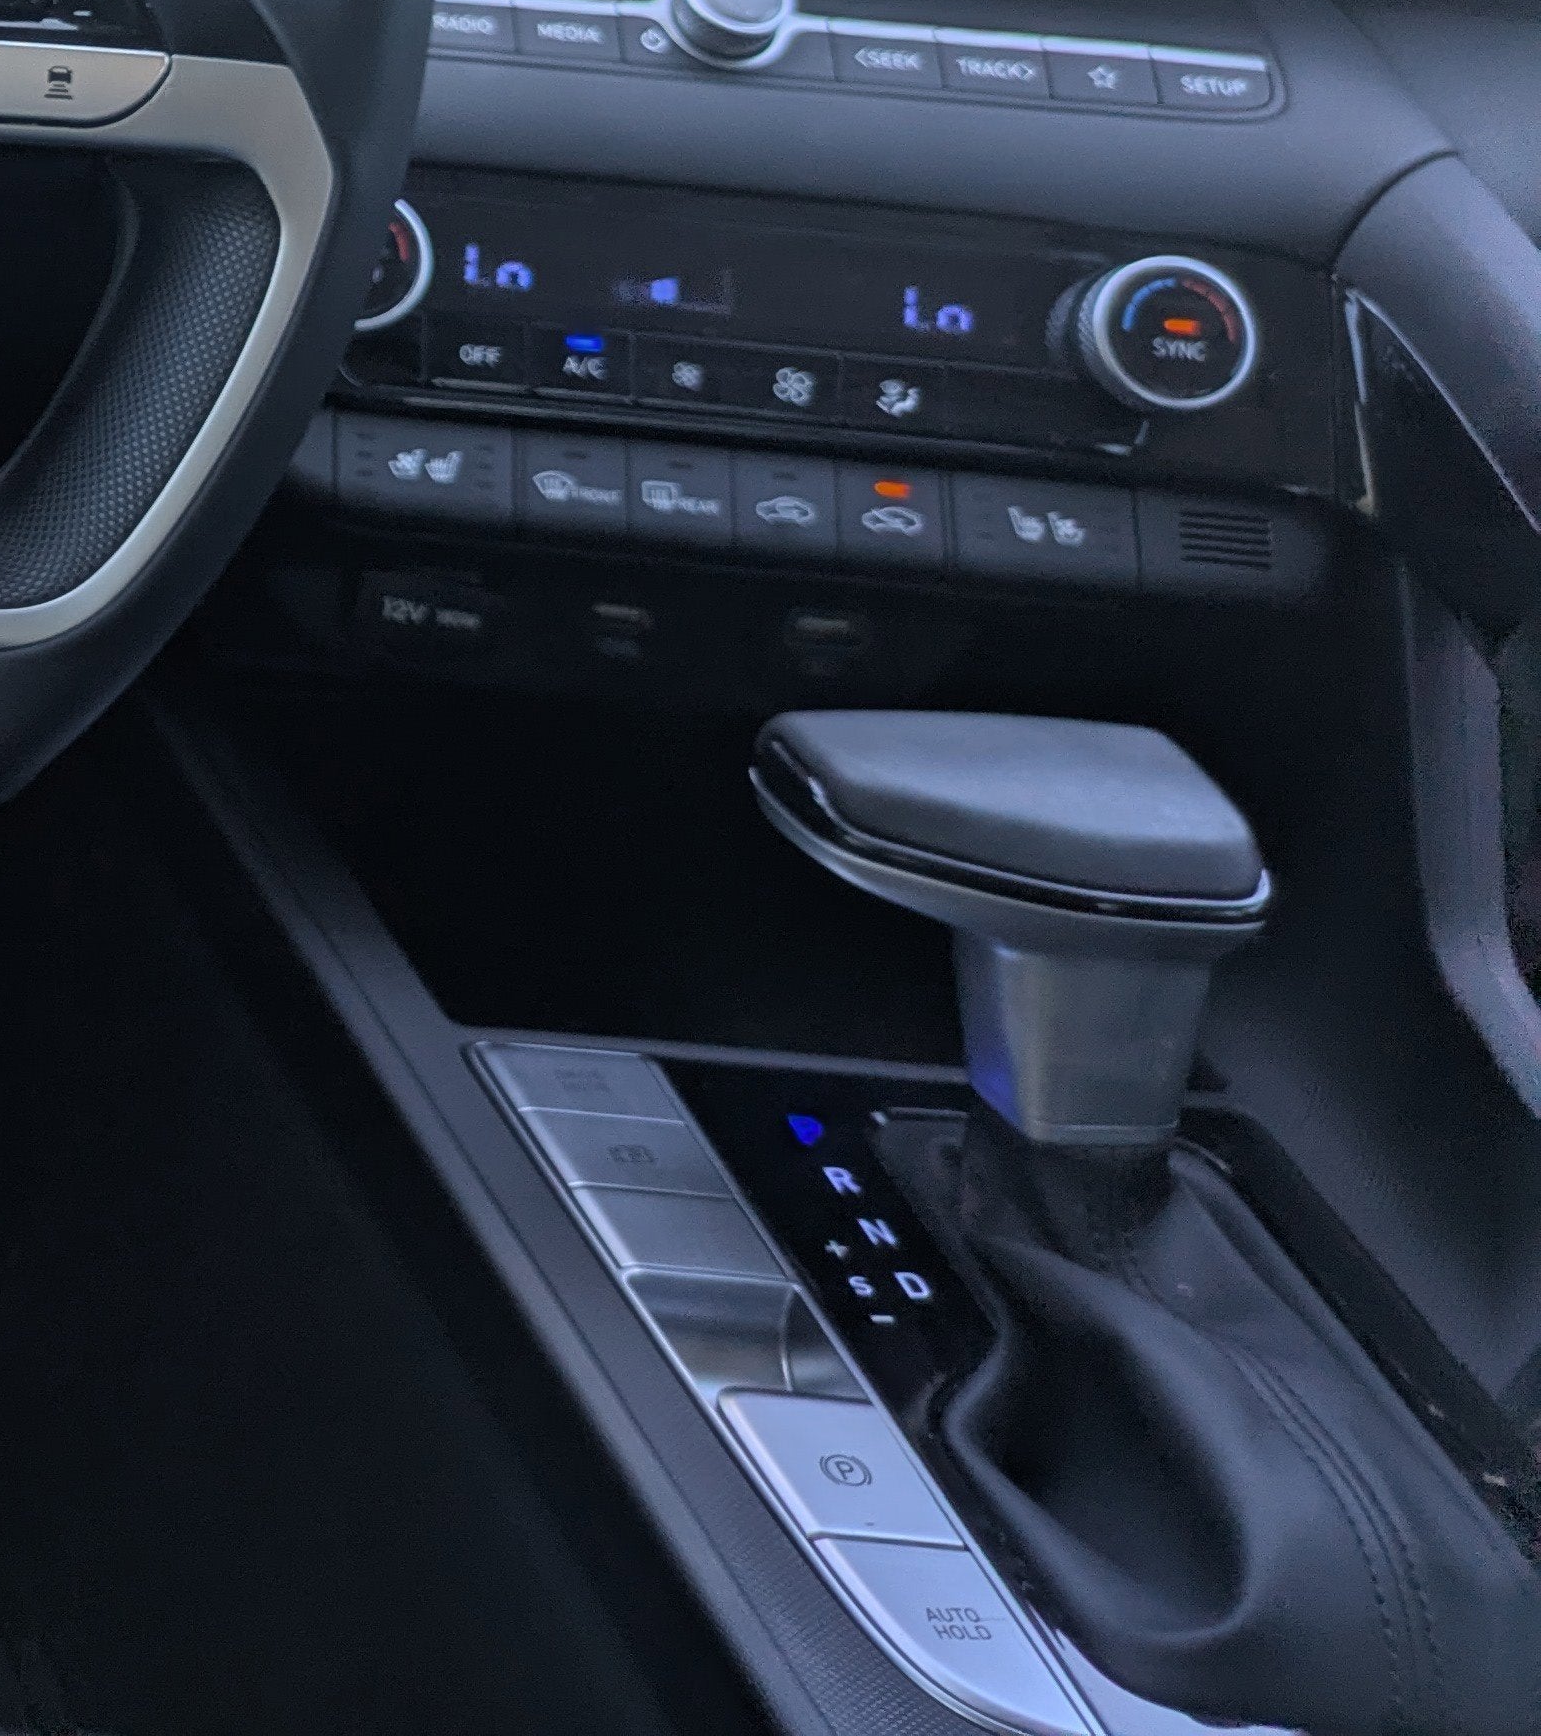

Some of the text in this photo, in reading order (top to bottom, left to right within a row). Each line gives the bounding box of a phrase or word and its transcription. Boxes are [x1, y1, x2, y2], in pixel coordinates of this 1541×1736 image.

[433, 11, 497, 36] RADIO
[536, 21, 605, 44] MEDIA
[1180, 74, 1247, 97] SETUP
[459, 343, 503, 367] OFF
[1151, 336, 1207, 363] SYNC
[822, 1166, 861, 1195] R
[858, 1218, 897, 1248] N
[849, 1271, 931, 1299] S D
[926, 1606, 980, 1624] AUTO
[933, 1623, 993, 1642] HOLD
